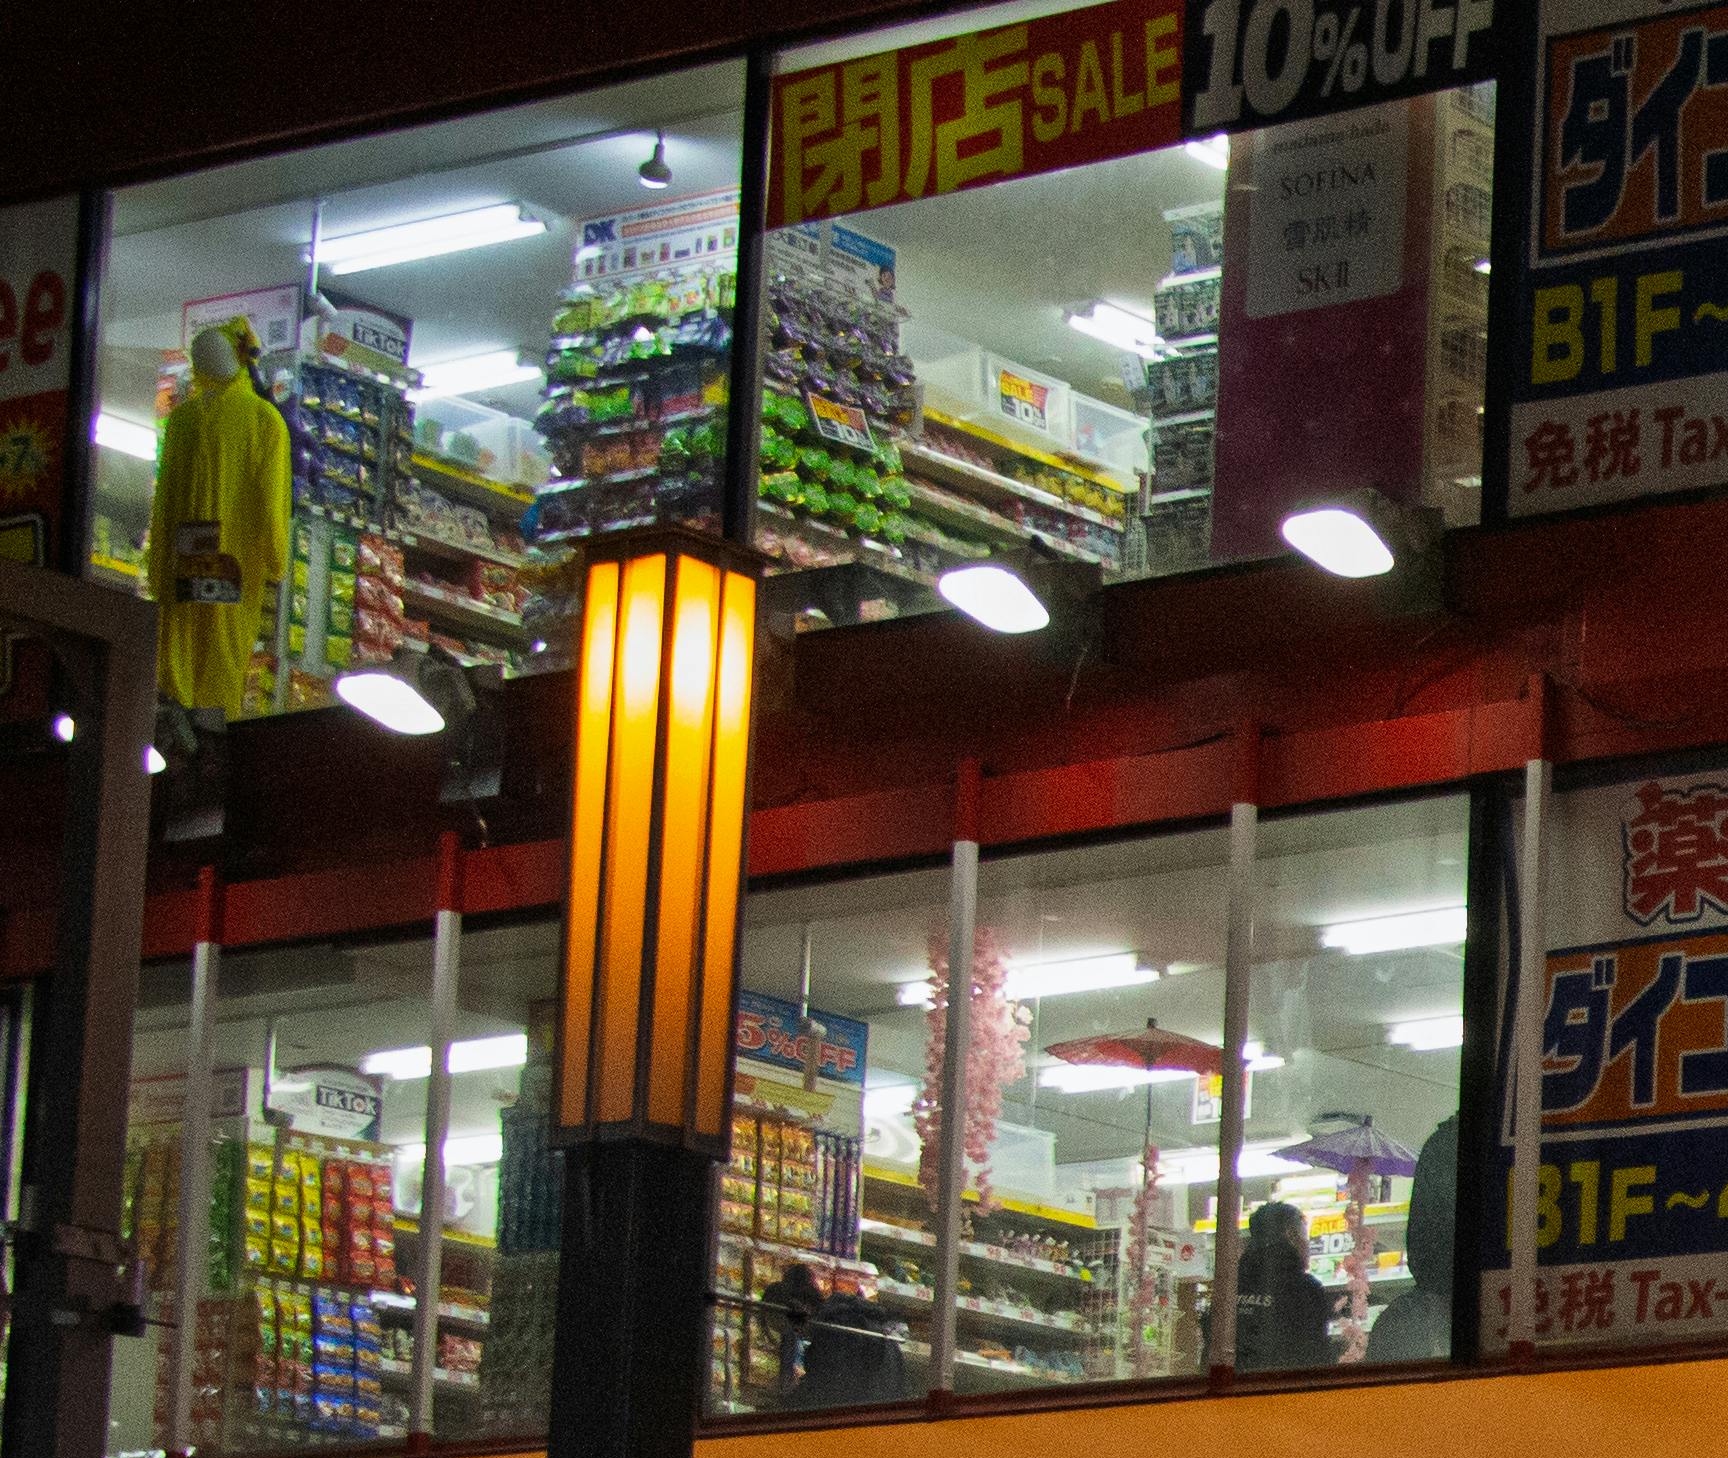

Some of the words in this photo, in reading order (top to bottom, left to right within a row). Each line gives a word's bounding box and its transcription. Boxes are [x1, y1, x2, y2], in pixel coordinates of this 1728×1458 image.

[781, 12, 1178, 218] 閉店SALE
[1195, 0, 1496, 127] 10%OFF
[1280, 163, 1377, 201] SOFINA
[1522, 406, 1642, 495] 免税
